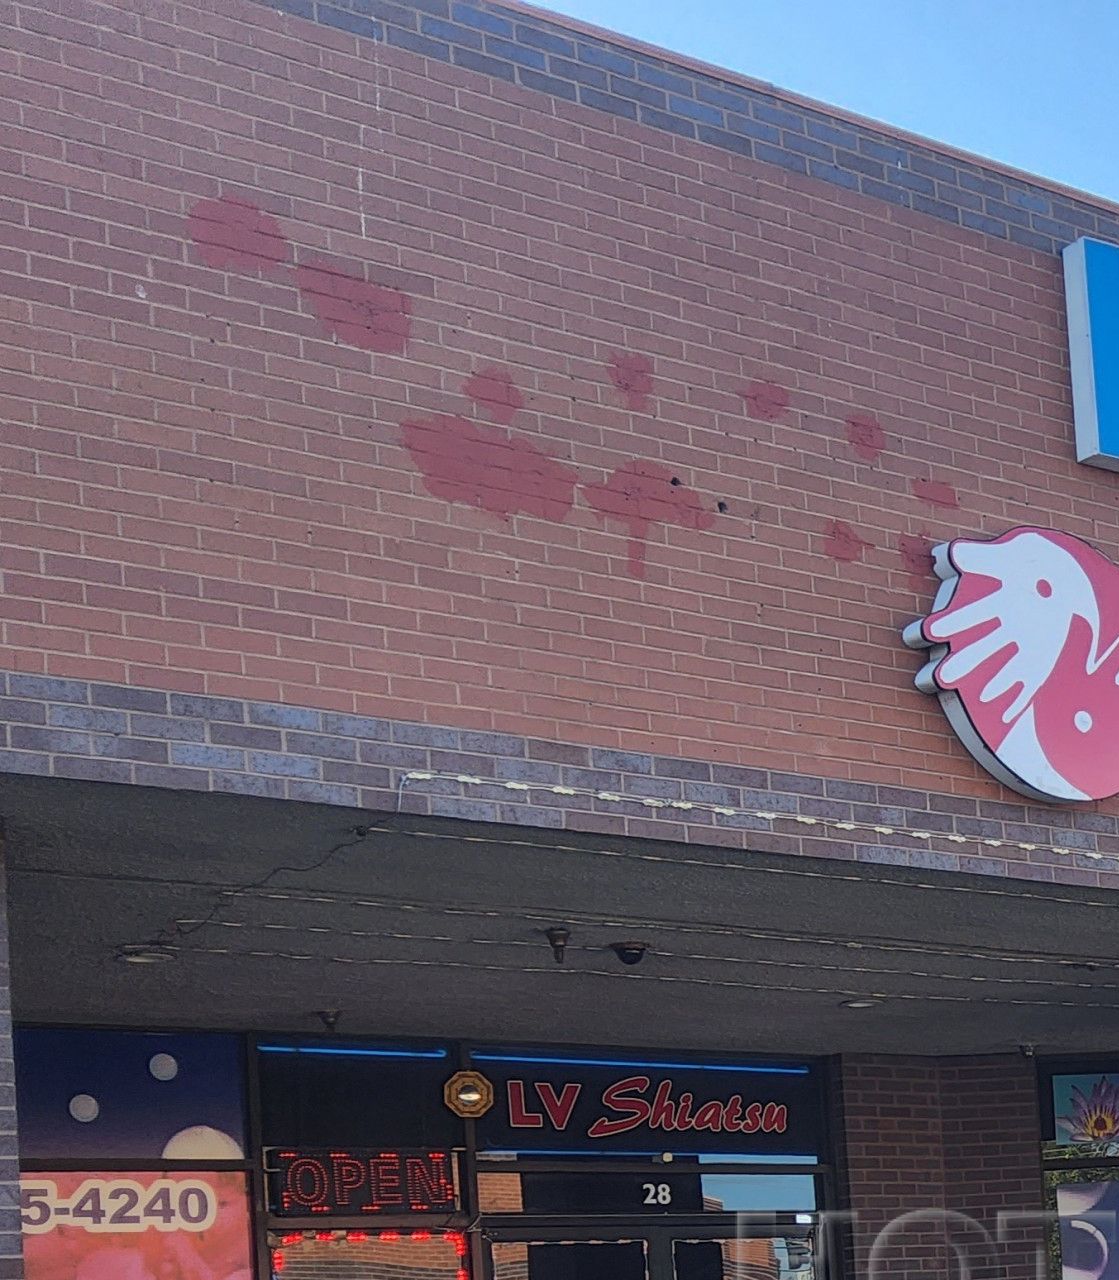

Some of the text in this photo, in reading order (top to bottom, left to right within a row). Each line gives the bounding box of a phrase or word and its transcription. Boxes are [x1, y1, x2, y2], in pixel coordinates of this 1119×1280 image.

[506, 1076, 789, 1138] LV Shiatsu
[286, 1158, 448, 1206] OPEN
[642, 1183, 671, 1206] 28
[20, 1187, 209, 1226] 5-4240
